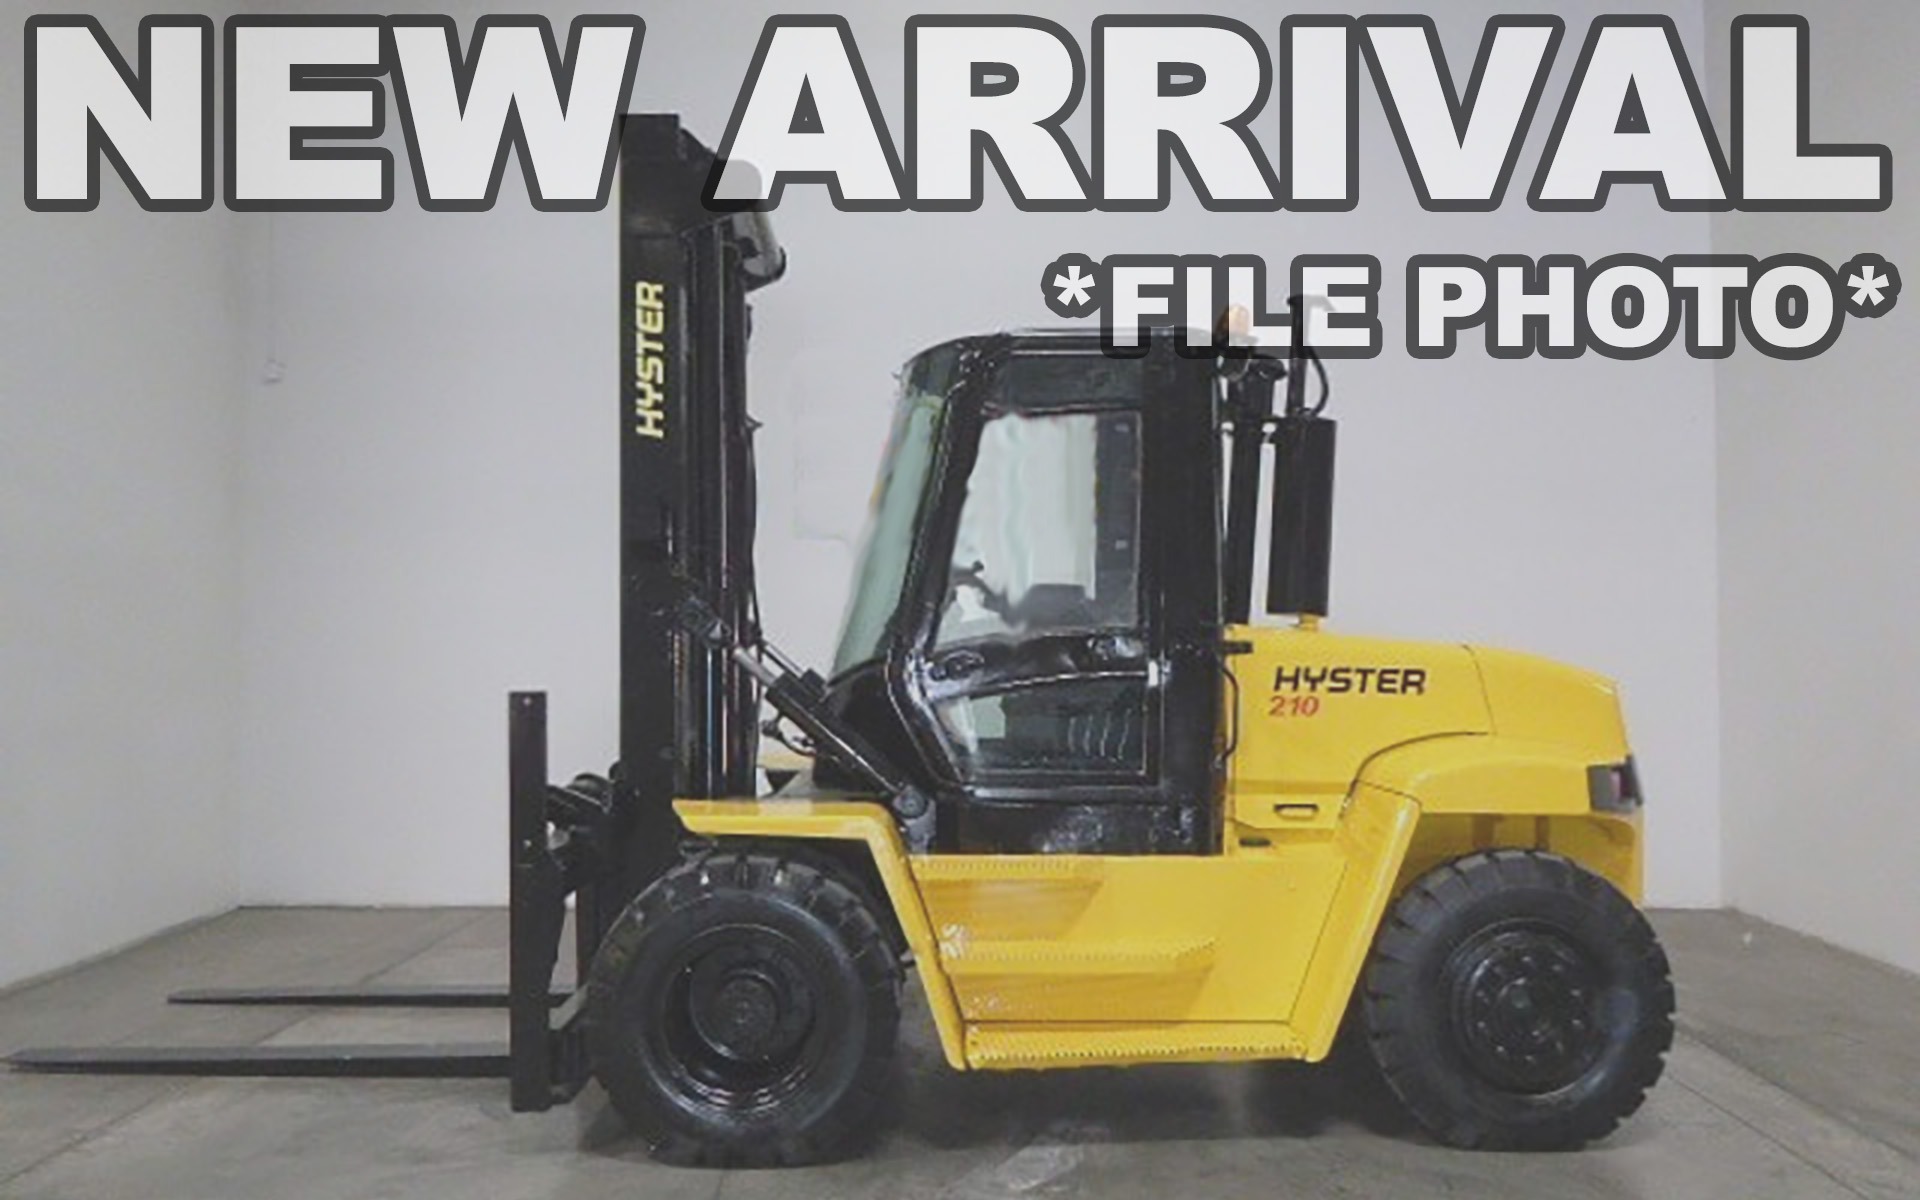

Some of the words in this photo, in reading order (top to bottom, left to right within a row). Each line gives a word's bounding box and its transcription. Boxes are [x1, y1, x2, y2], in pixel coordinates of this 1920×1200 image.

[635, 280, 665, 439] HYSTER
[1273, 665, 1427, 696] HYSTER
[1268, 695, 1320, 718] 210
